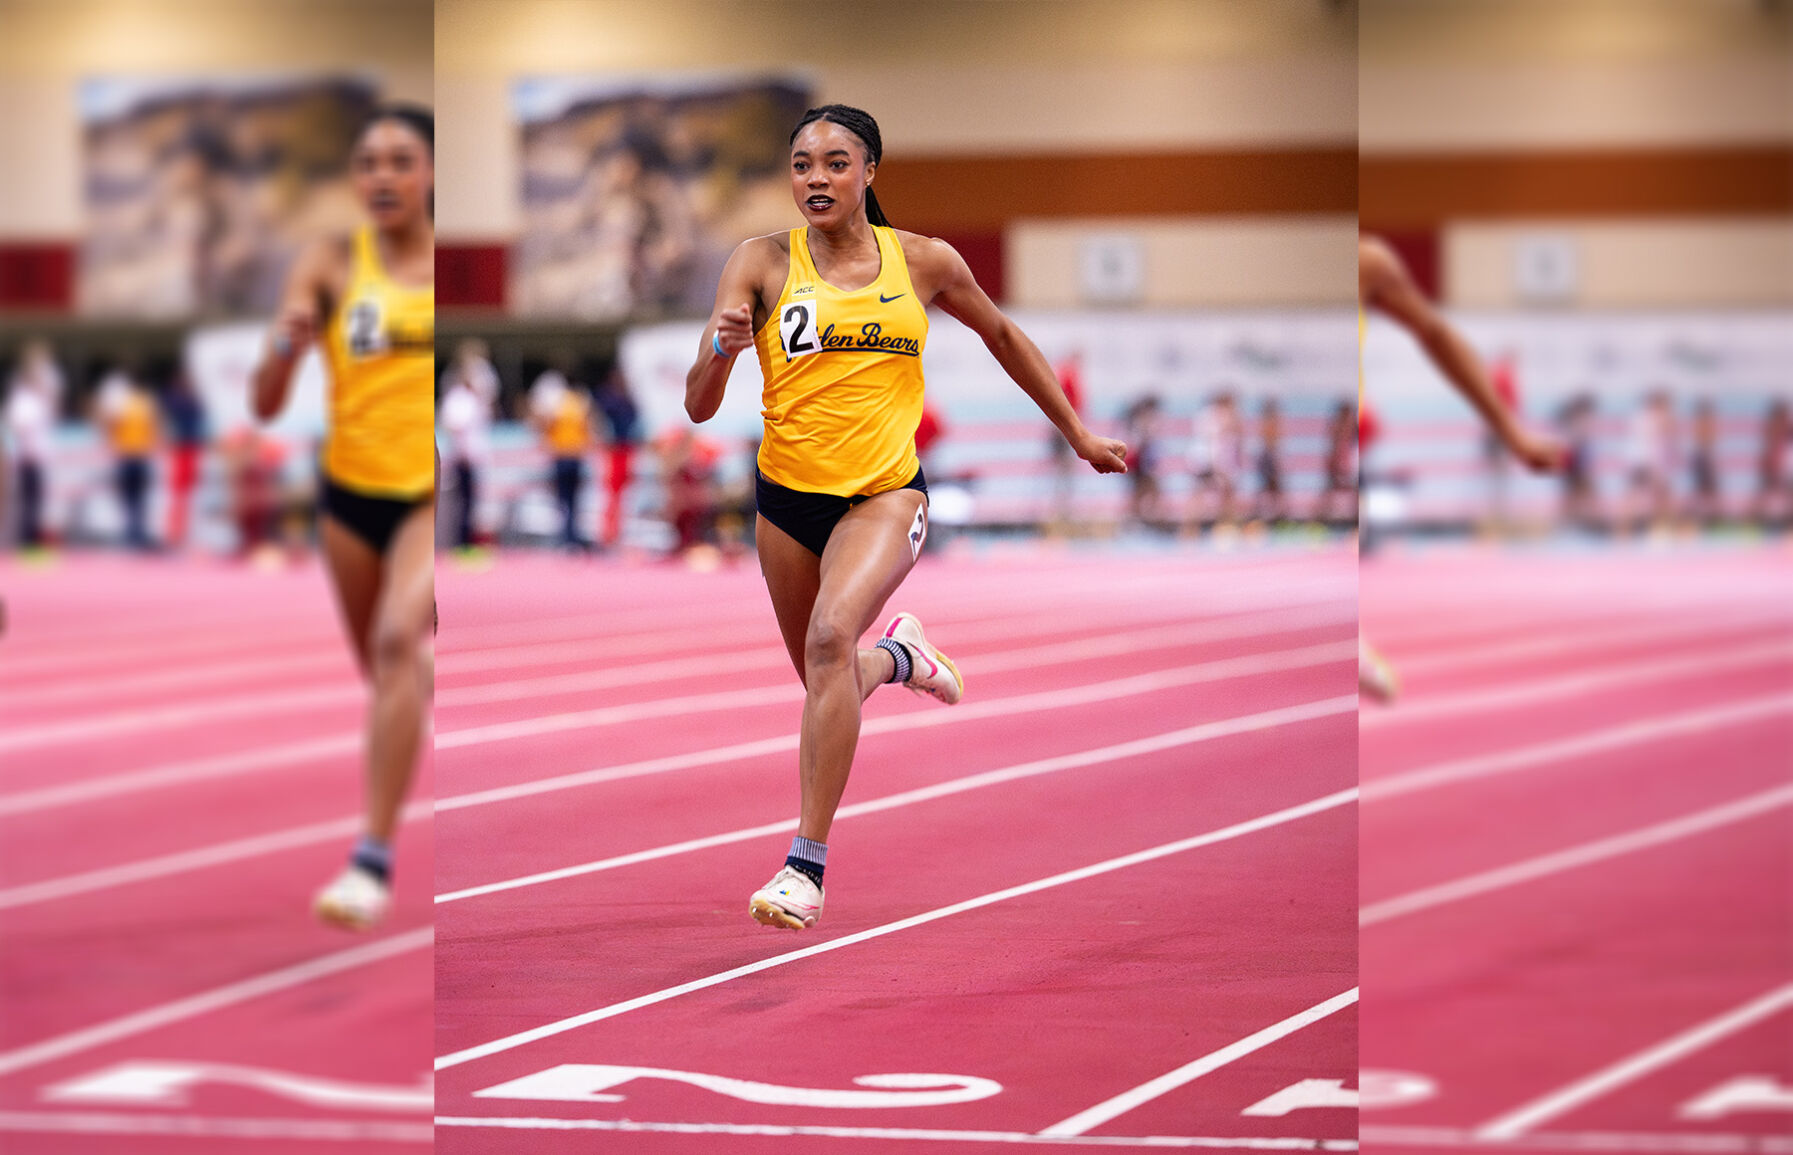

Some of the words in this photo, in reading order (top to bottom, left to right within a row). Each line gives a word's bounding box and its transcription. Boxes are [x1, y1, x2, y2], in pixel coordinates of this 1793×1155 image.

[793, 286, 815, 295] ACC
[784, 305, 814, 353] 2
[857, 322, 919, 352] Bears
[472, 1064, 1003, 1108] 2
